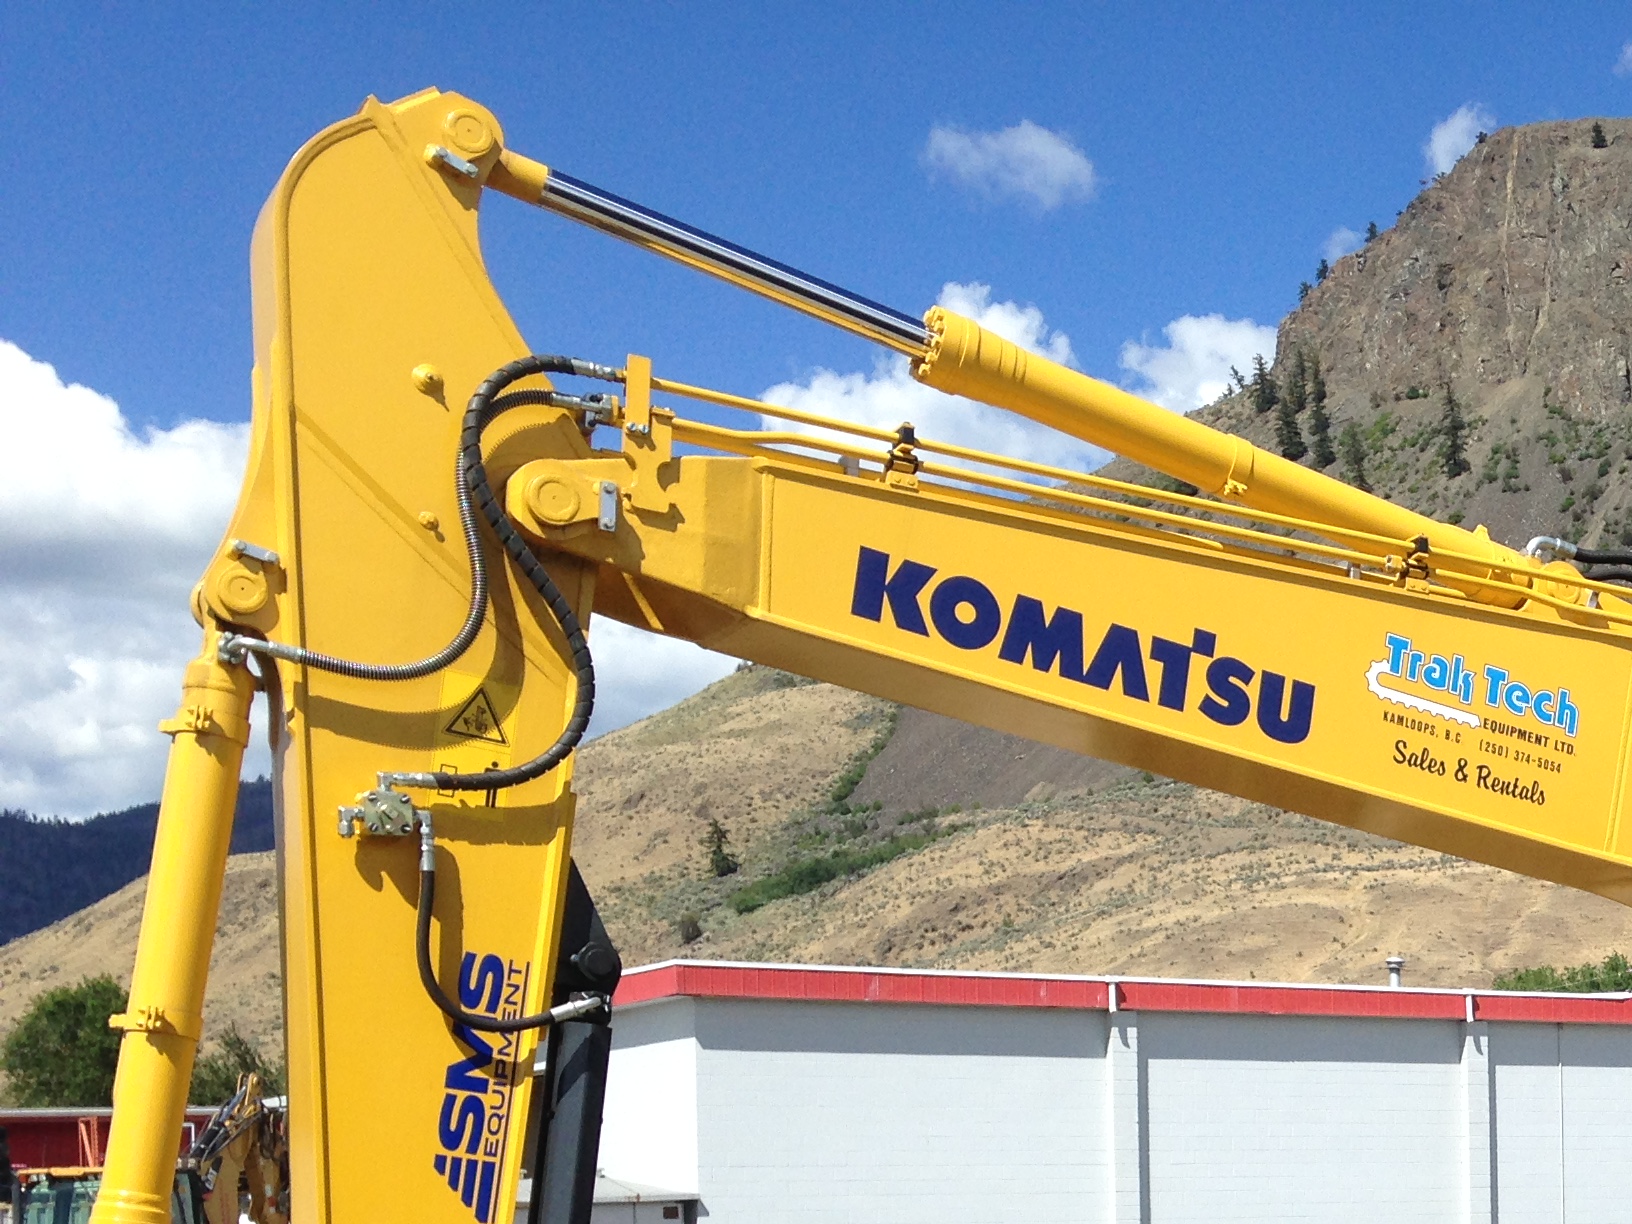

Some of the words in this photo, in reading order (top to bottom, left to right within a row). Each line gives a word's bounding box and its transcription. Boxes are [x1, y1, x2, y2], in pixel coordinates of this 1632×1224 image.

[851, 545, 1316, 744] KOMATSU
[1385, 632, 1476, 705] Trak
[1484, 663, 1579, 738] Tech
[1383, 710, 1439, 738] KAMLOOPS,
[1479, 739, 1508, 758] (250)
[1514, 750, 1562, 774] 374-5054
[1483, 718, 1550, 748] EQUIPMENT
[1554, 739, 1577, 756] LTD.
[1392, 739, 1447, 776] Sales
[1454, 757, 1469, 783] &
[1476, 764, 1546, 806] Rentals
[484, 959, 522, 1157] EQUIPMENT
[204, 1166, 217, 1190] CAT
